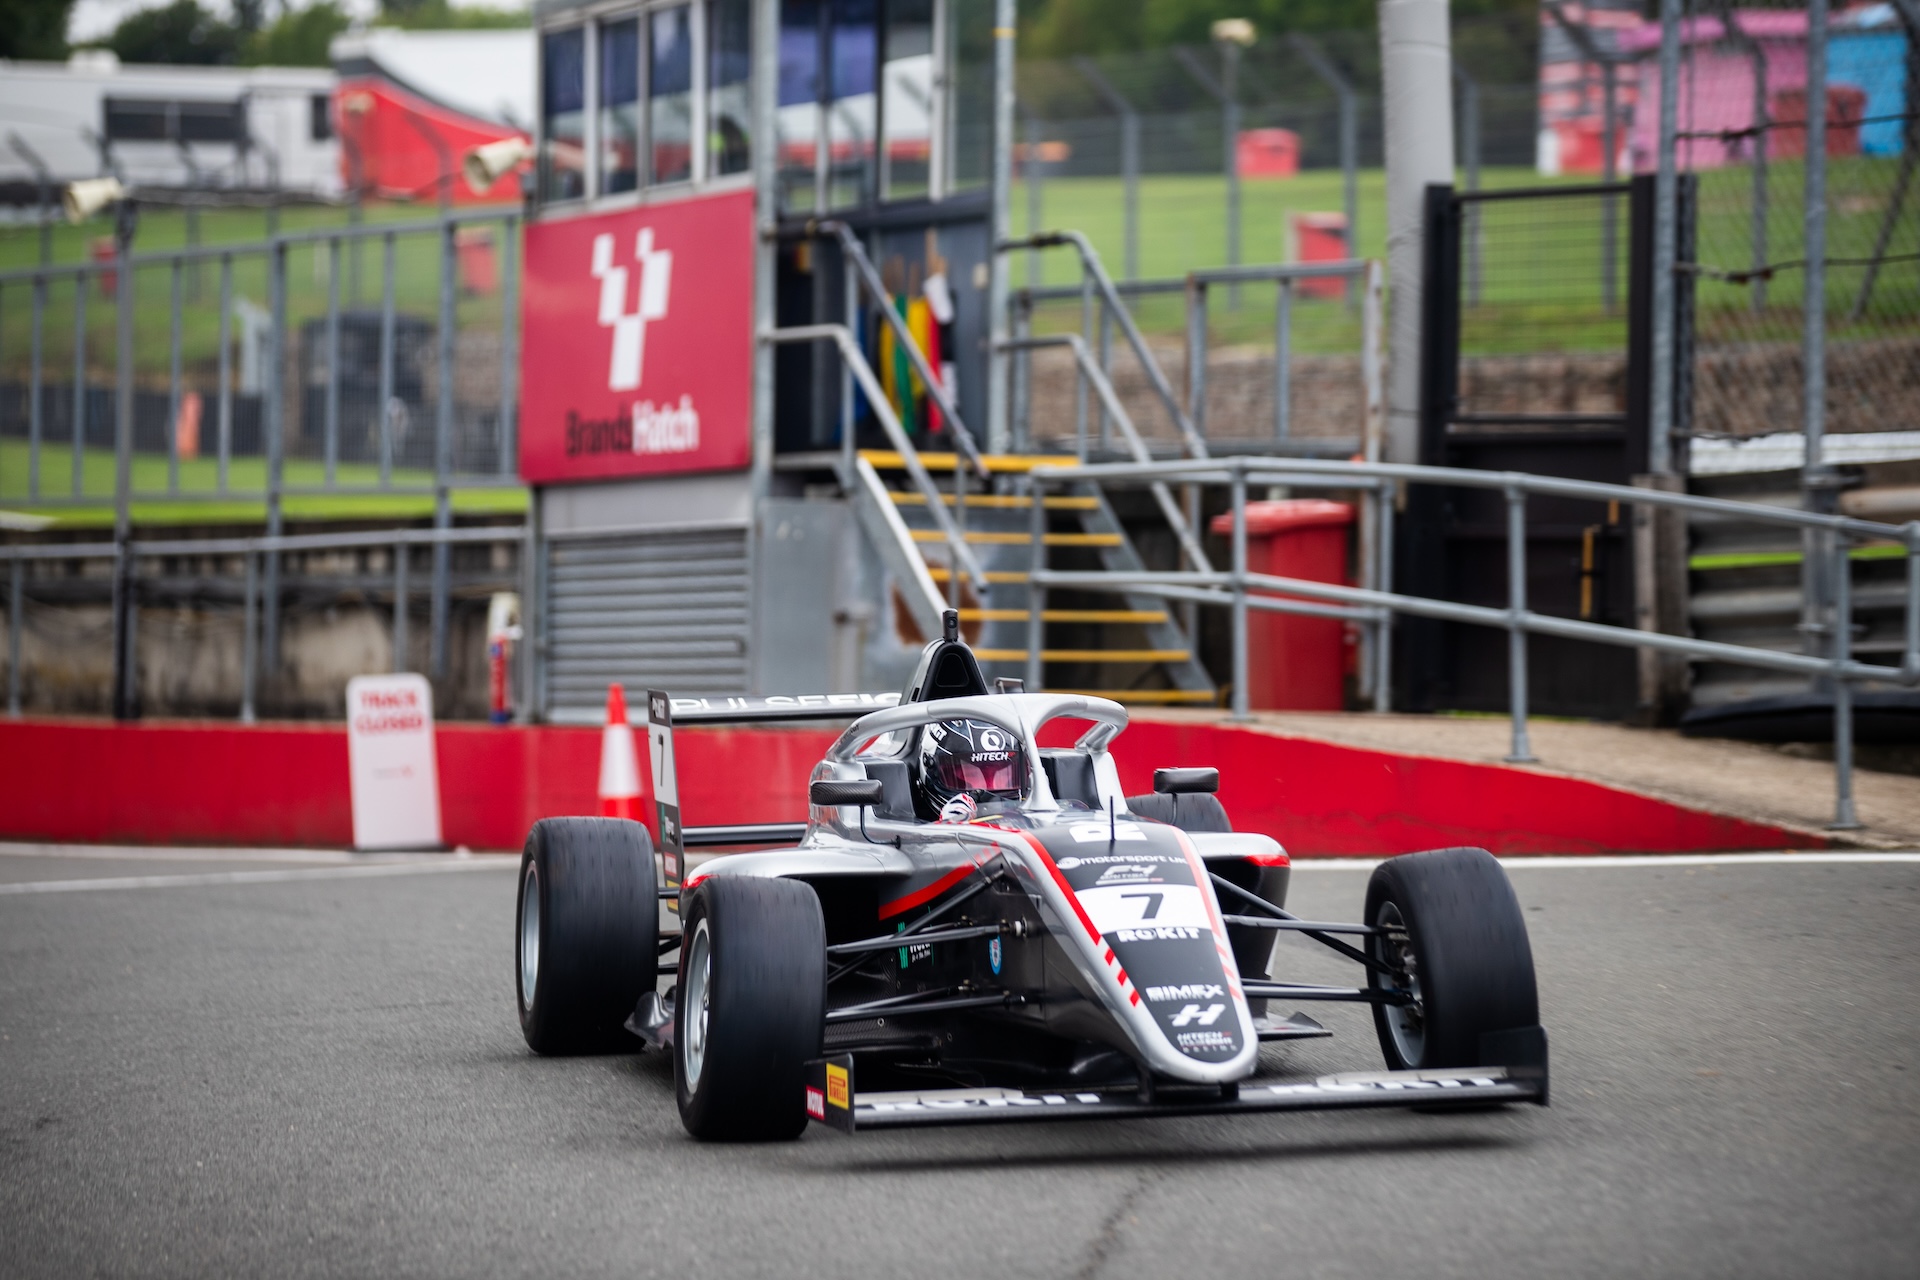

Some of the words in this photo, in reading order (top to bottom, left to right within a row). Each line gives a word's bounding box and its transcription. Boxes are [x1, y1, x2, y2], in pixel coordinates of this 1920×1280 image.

[971, 751, 1009, 762] HITECH
[1121, 893, 1164, 919] 7
[829, 1075, 847, 1102] PIRELLI
